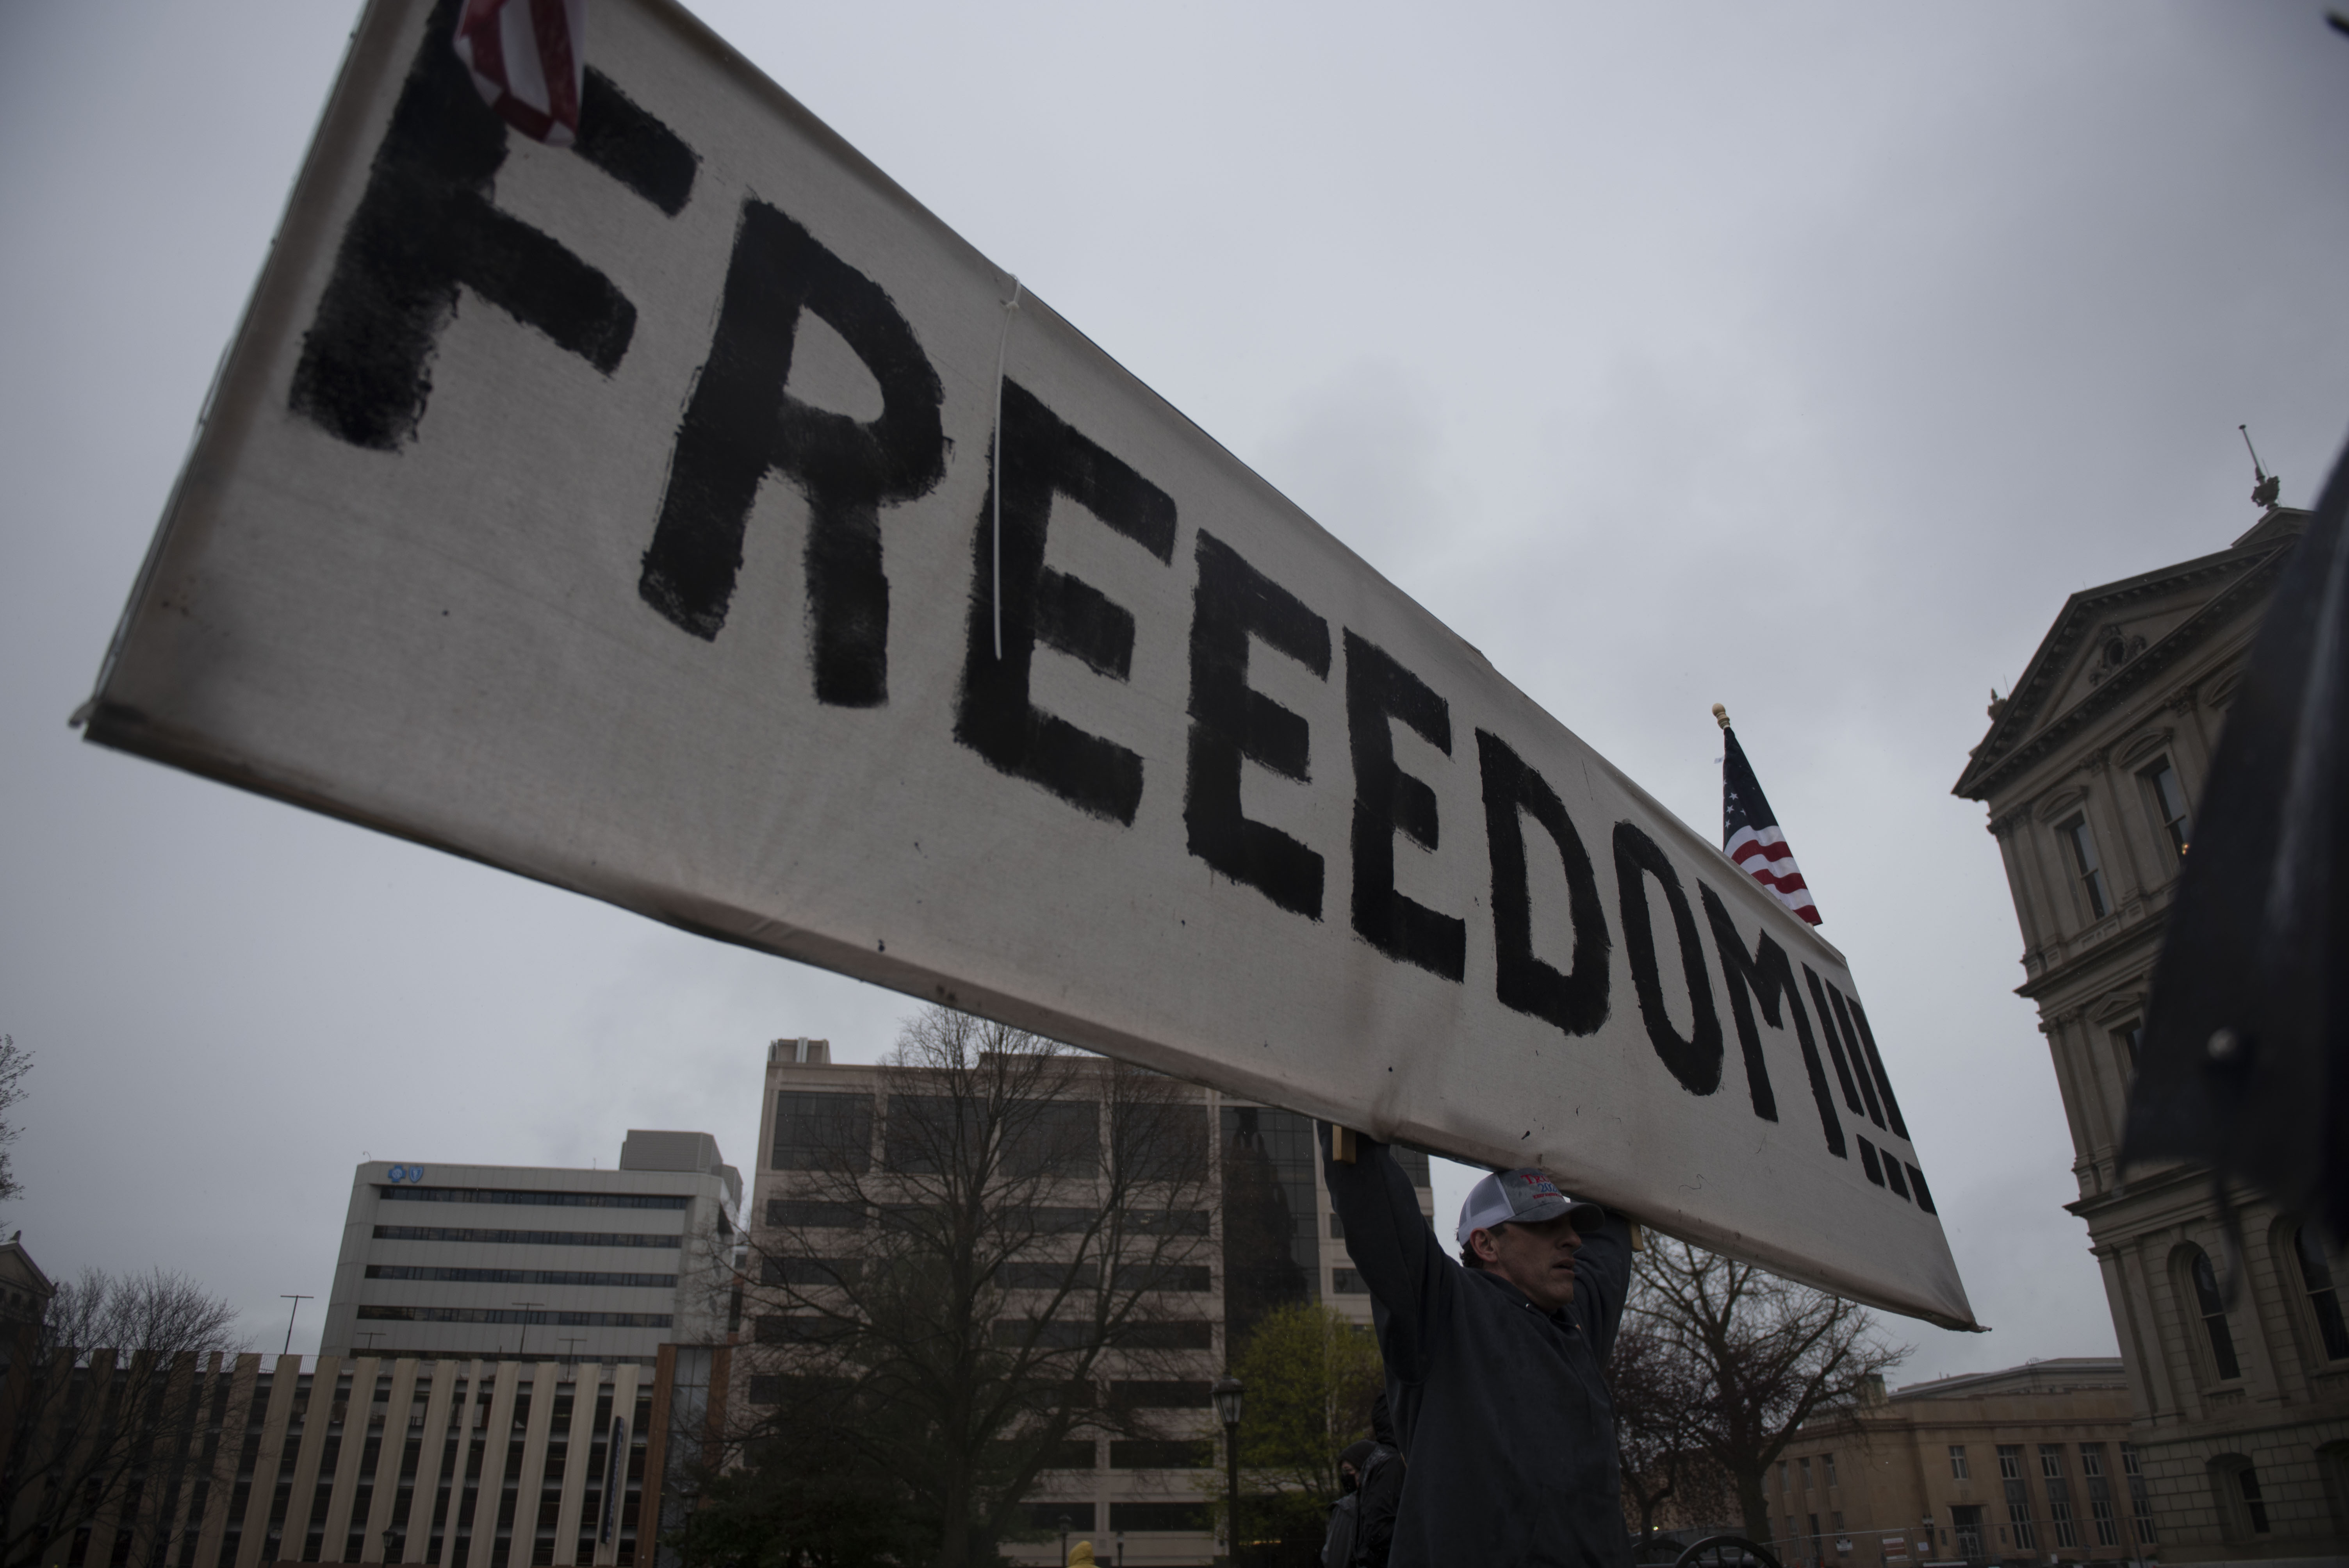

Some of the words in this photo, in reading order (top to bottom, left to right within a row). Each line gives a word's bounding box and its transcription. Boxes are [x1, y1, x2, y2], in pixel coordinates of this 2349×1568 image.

[288, 0, 1937, 1215] FREEDOM!!!
[1520, 1174, 1551, 1184] TRU
[1538, 1183, 1558, 1192] 202
